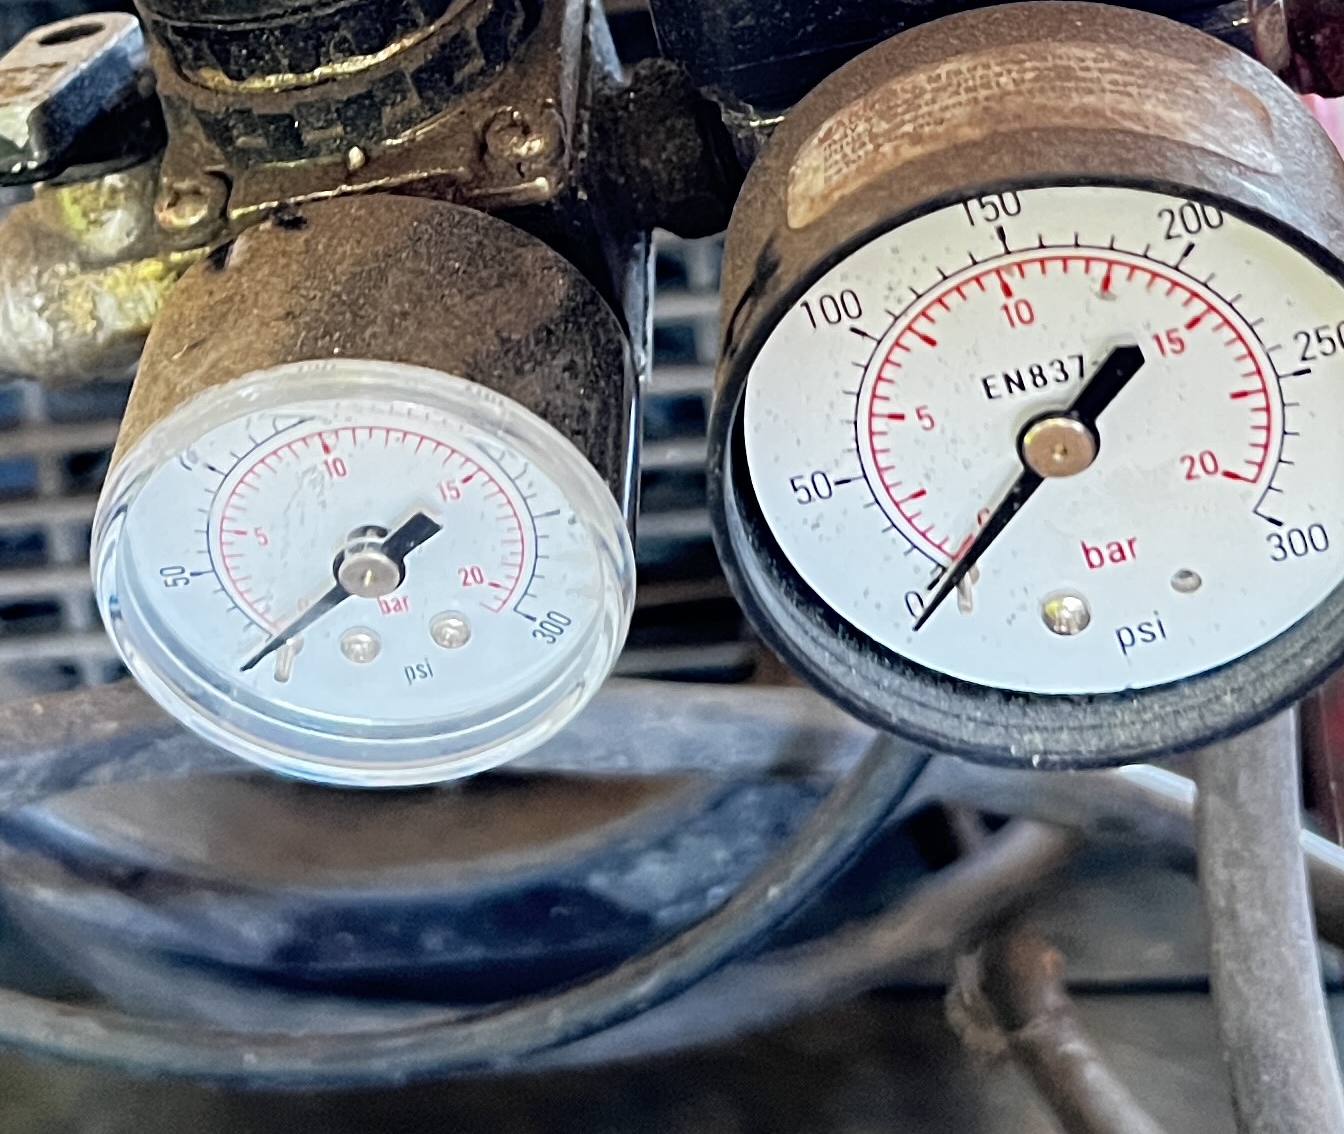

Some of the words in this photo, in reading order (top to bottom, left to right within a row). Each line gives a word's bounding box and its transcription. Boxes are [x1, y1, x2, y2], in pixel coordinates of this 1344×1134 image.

[961, 191, 1023, 228] 150
[1157, 203, 1225, 242] 200
[799, 288, 864, 330] 100
[1001, 298, 1035, 328] 10
[1152, 328, 1185, 357] 15
[916, 407, 935, 431] 5
[323, 457, 348, 479] 10
[1179, 450, 1219, 481] 20
[438, 480, 461, 502] 15
[790, 471, 834, 504] 50
[253, 527, 269, 547] 5
[1081, 533, 1139, 569] bar
[1266, 522, 1329, 562] 300
[159, 565, 191, 588] 50
[458, 565, 485, 587] 20
[377, 594, 410, 617] bar
[532, 610, 573, 645] 300
[1113, 609, 1168, 654] psi
[404, 658, 434, 686] psi
